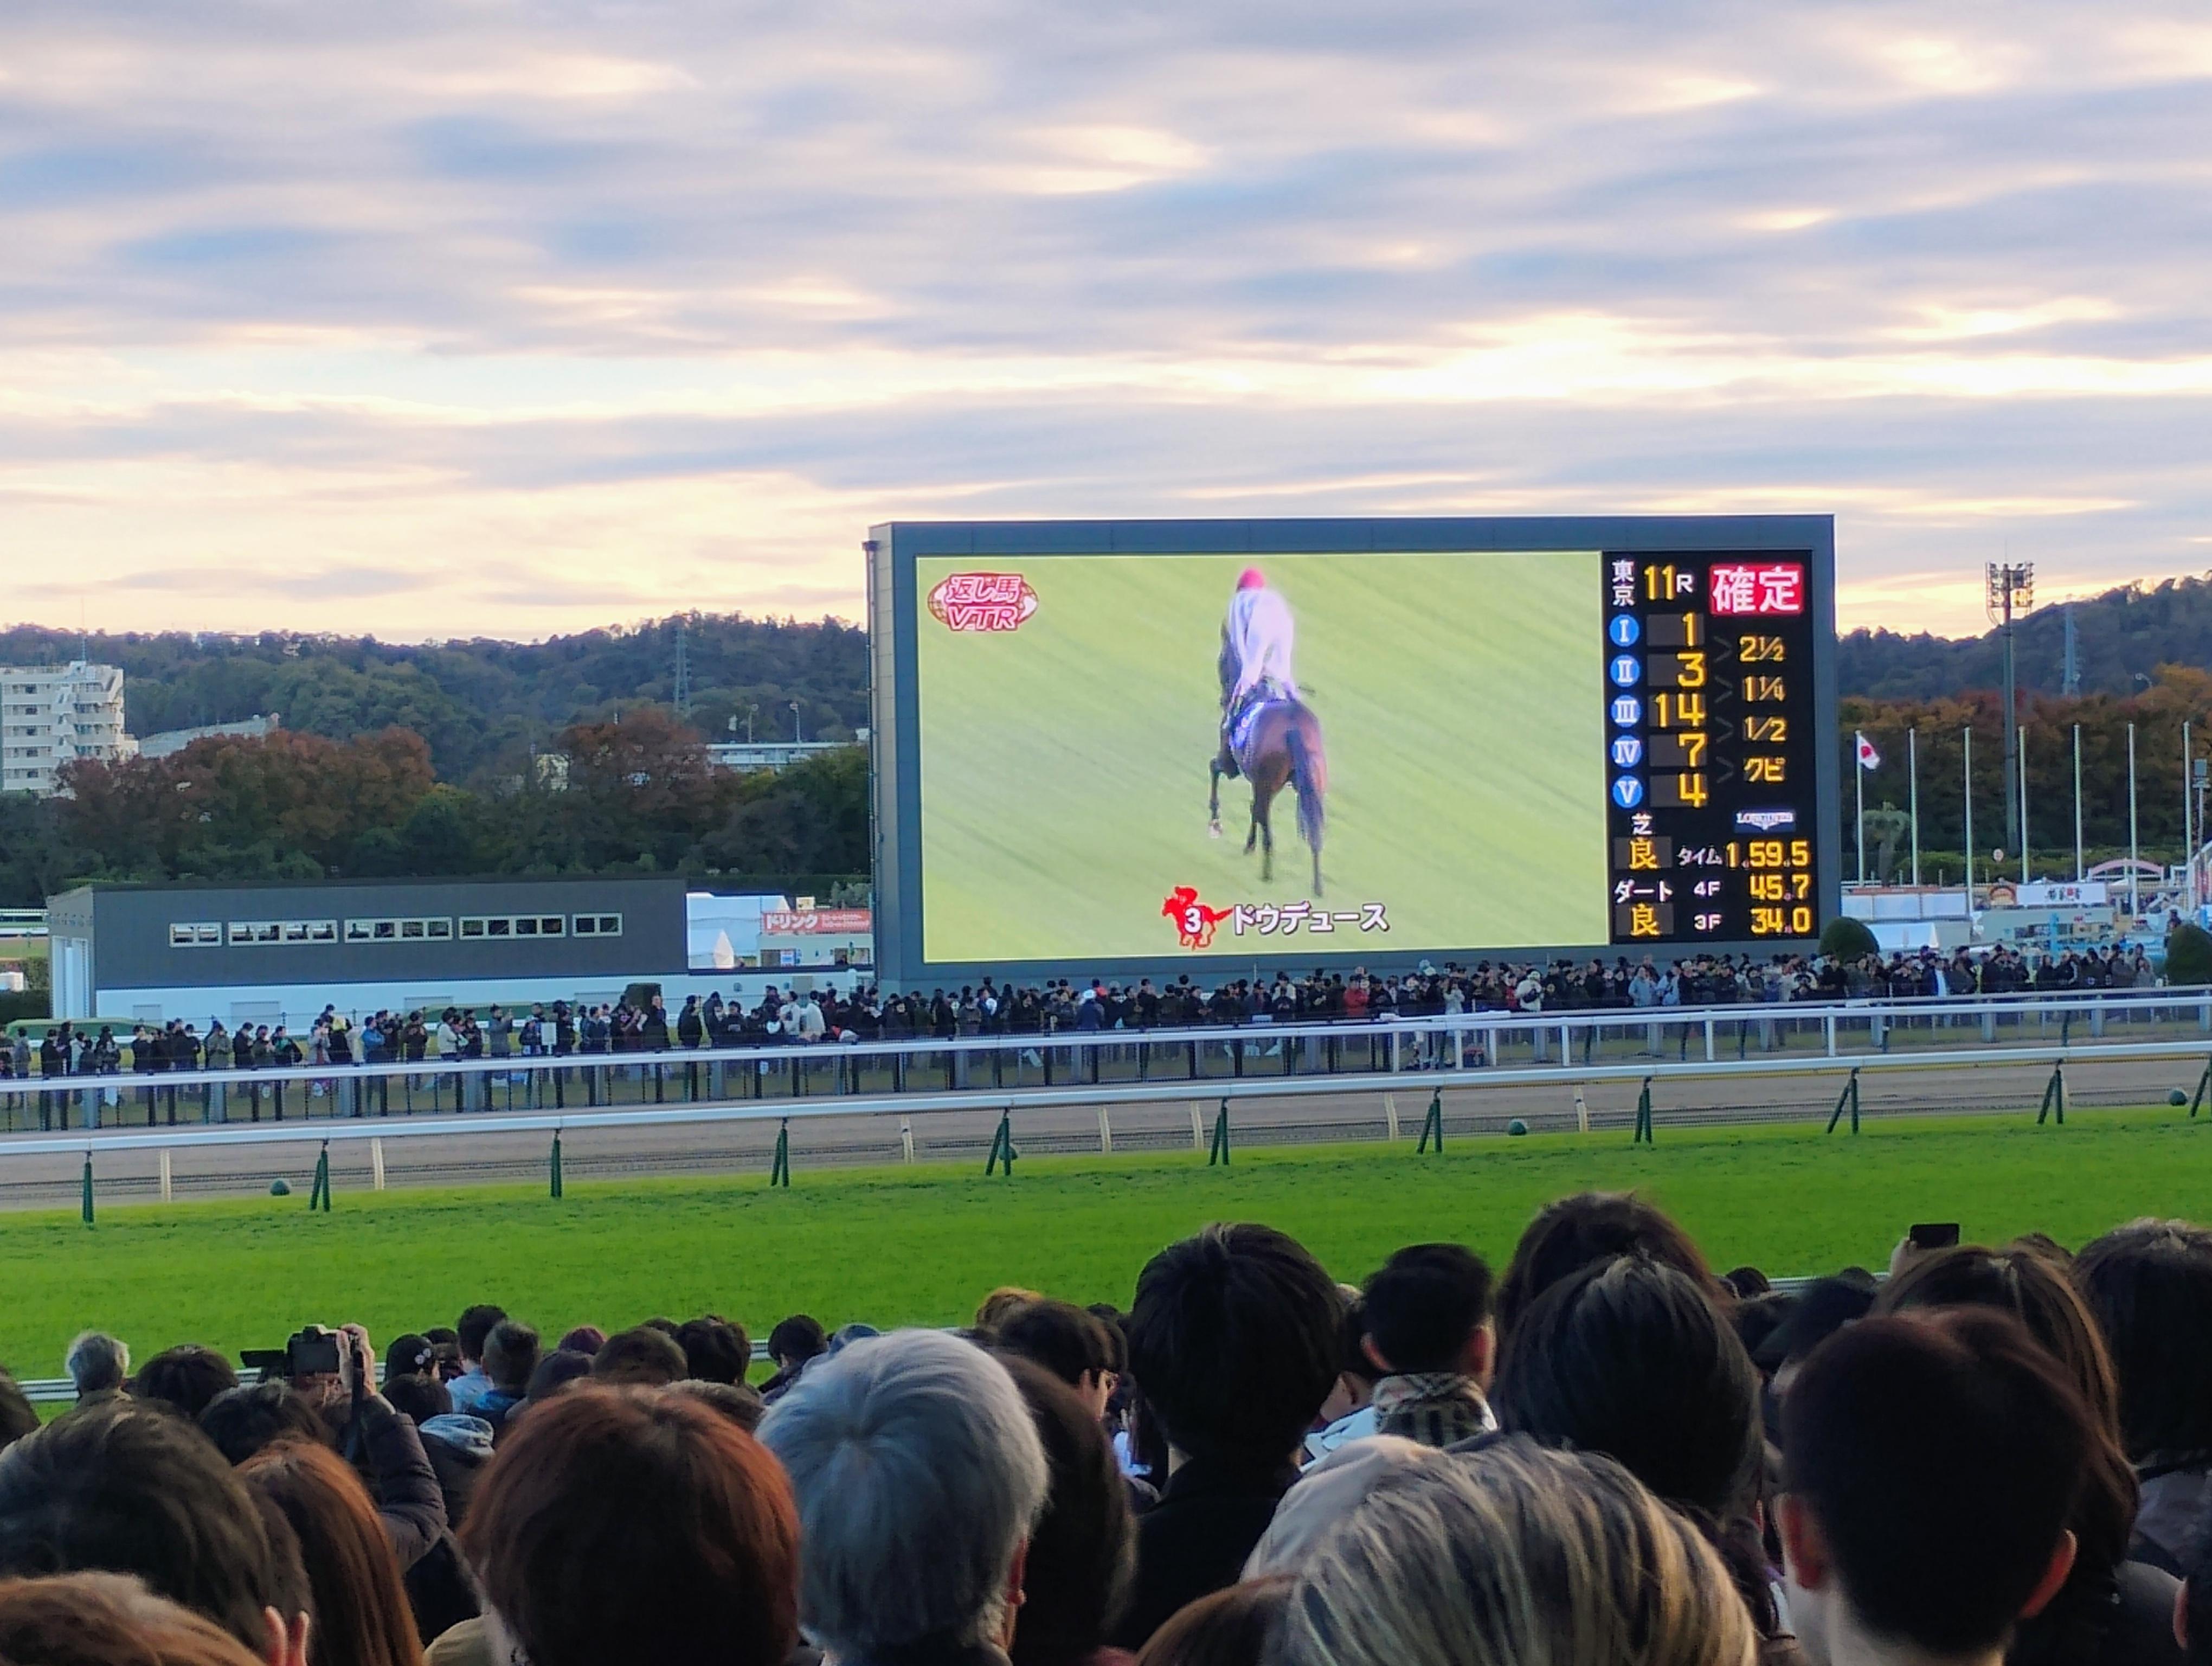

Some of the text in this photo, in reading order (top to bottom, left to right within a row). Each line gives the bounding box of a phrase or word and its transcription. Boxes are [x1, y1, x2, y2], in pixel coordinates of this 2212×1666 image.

[1612, 560, 1636, 606] 東京
[1712, 566, 1800, 613] 確定
[948, 605, 1018, 630] VTR
[1682, 612, 1694, 647] 1
[1677, 652, 1706, 687] 3
[1655, 693, 1706, 728] 14
[1678, 733, 1706, 767] 7
[1680, 773, 1707, 808] 4
[1631, 813, 1654, 835] 芝
[1629, 837, 1659, 870] 良
[1677, 847, 1722, 866] タイム
[1614, 879, 1674, 904] ダート
[1693, 874, 1810, 901] 4F 45.7
[766, 914, 818, 930] ドリンク
[1184, 907, 1203, 934] 3
[1233, 901, 1390, 935] ドウデュース
[1630, 904, 1660, 937] 良
[1694, 906, 1811, 934] 3F 34.0
